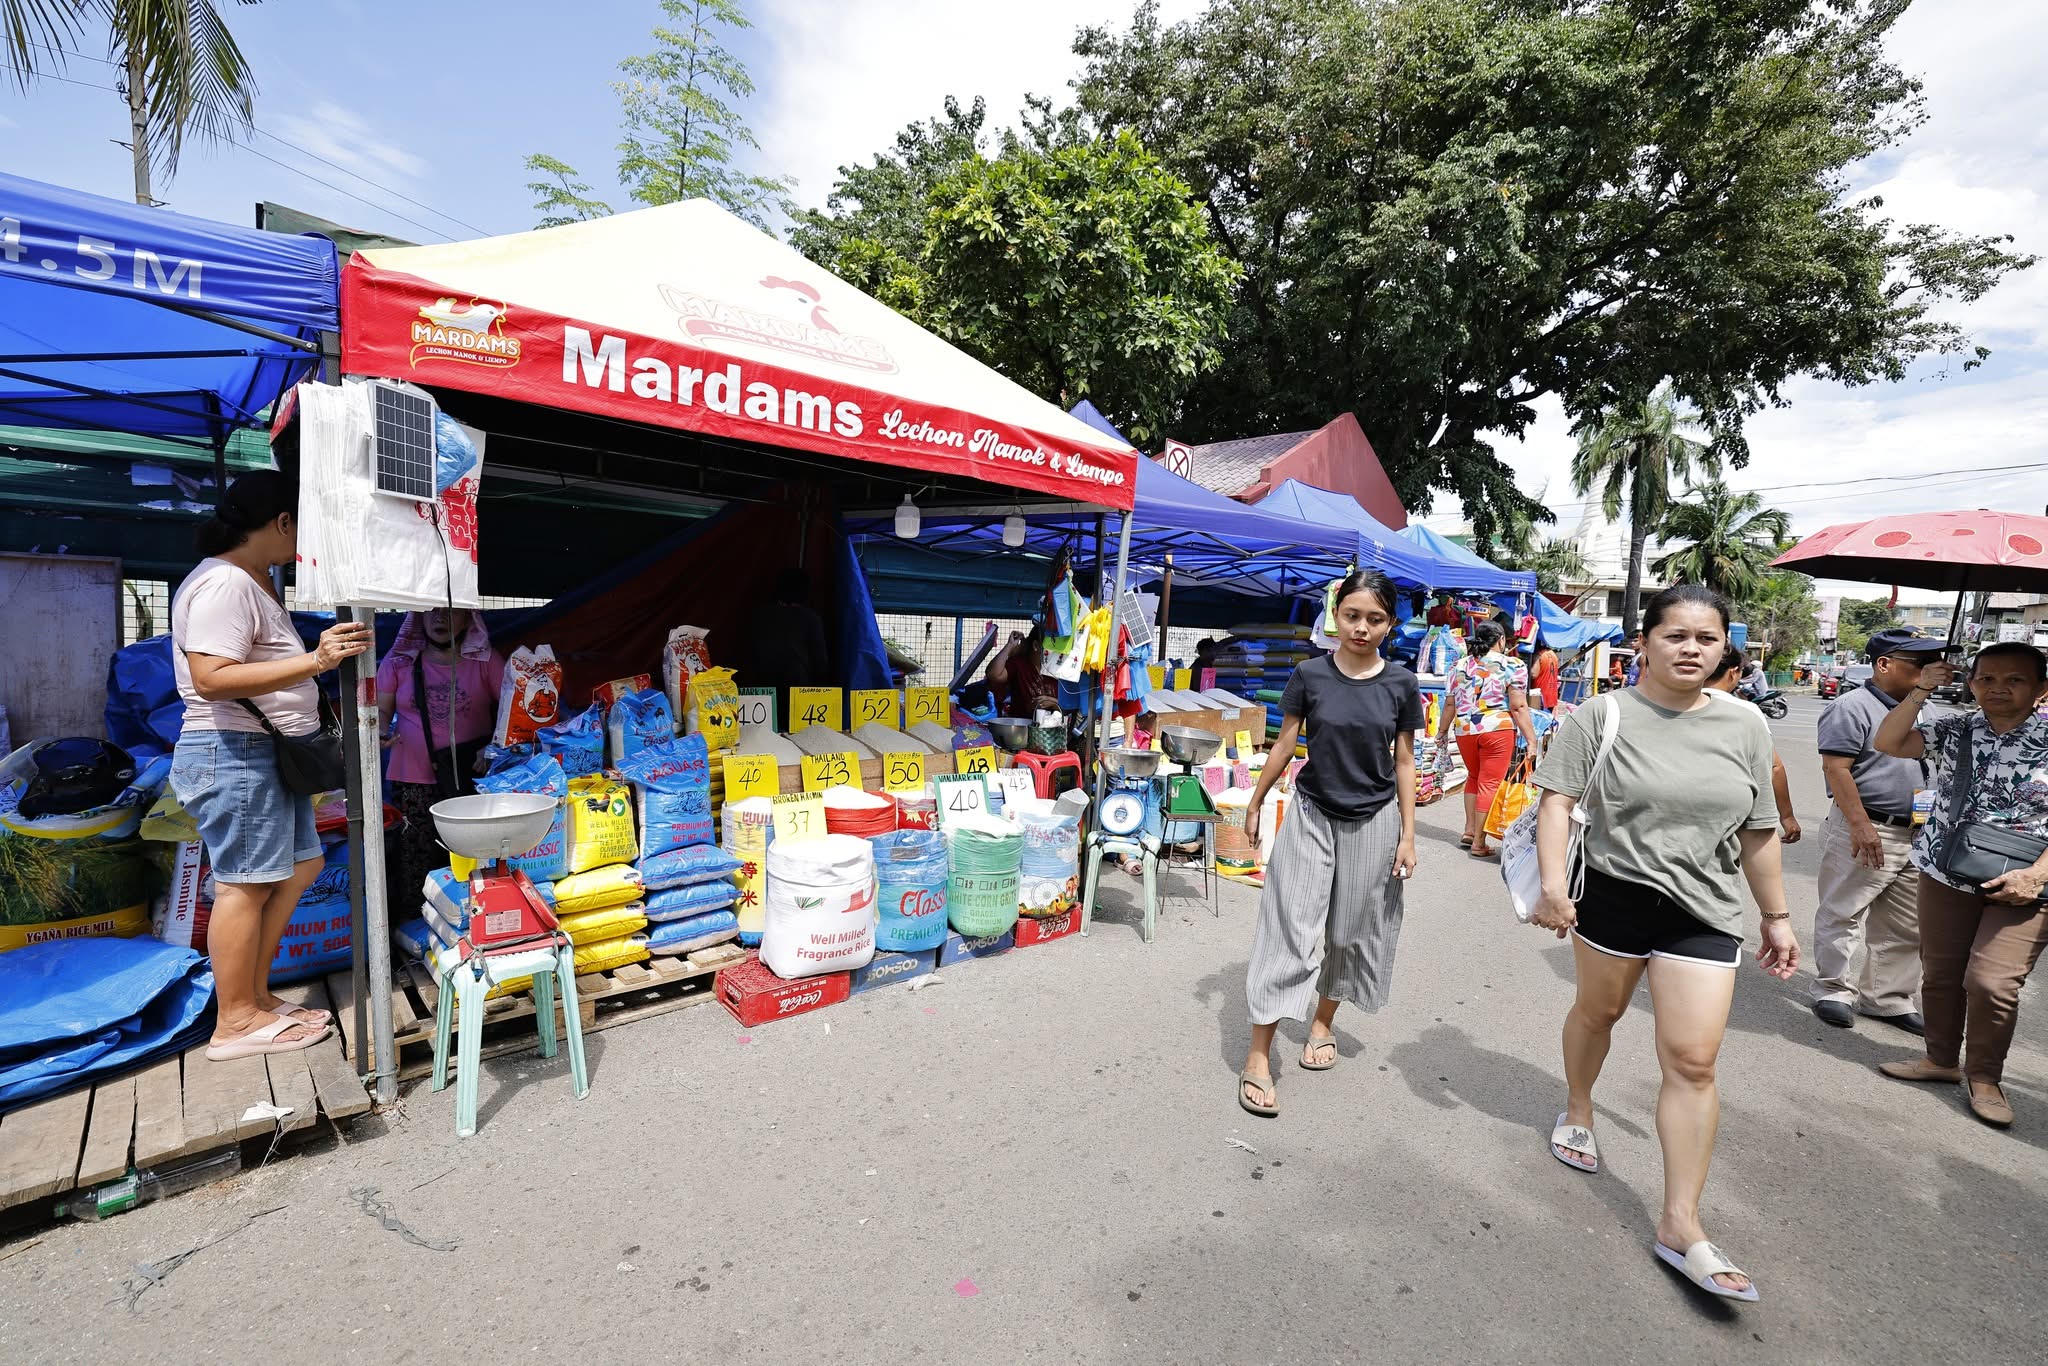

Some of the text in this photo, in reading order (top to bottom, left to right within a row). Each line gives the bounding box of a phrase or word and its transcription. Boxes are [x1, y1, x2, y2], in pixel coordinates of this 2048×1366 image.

[412, 323, 520, 357] MARDAMS
[426, 346, 507, 364] LECHON MANOK & LIEMPO
[563, 325, 864, 438] Mardams
[878, 409, 965, 449] Lechon
[968, 428, 1046, 466] Manok
[1050, 452, 1061, 473] &
[1065, 453, 1125, 486] Liempo
[801, 703, 828, 726] 48
[862, 697, 890, 721] 52
[914, 694, 945, 720] 54
[810, 752, 846, 763] THAILAND
[967, 757, 990, 774] 48
[738, 767, 762, 791] 40
[815, 761, 850, 788] 43
[889, 761, 920, 785] 50
[1009, 778, 1028, 791] 45
[772, 794, 799, 805] BROKEN
[949, 789, 979, 812] 40
[671, 821, 701, 831] PREMIUM
[787, 811, 810, 836] 37
[672, 834, 686, 843] NET
[175, 861, 198, 922] Jasmine
[975, 893, 998, 908] CORN
[26, 919, 116, 944] YGAÑA RICE MILL
[810, 926, 867, 945] Well Milled
[288, 941, 317, 960] WT.
[797, 937, 871, 962] Fragrance Rice
[957, 935, 1000, 955] COSMOS
[867, 957, 919, 981] COSMOS
